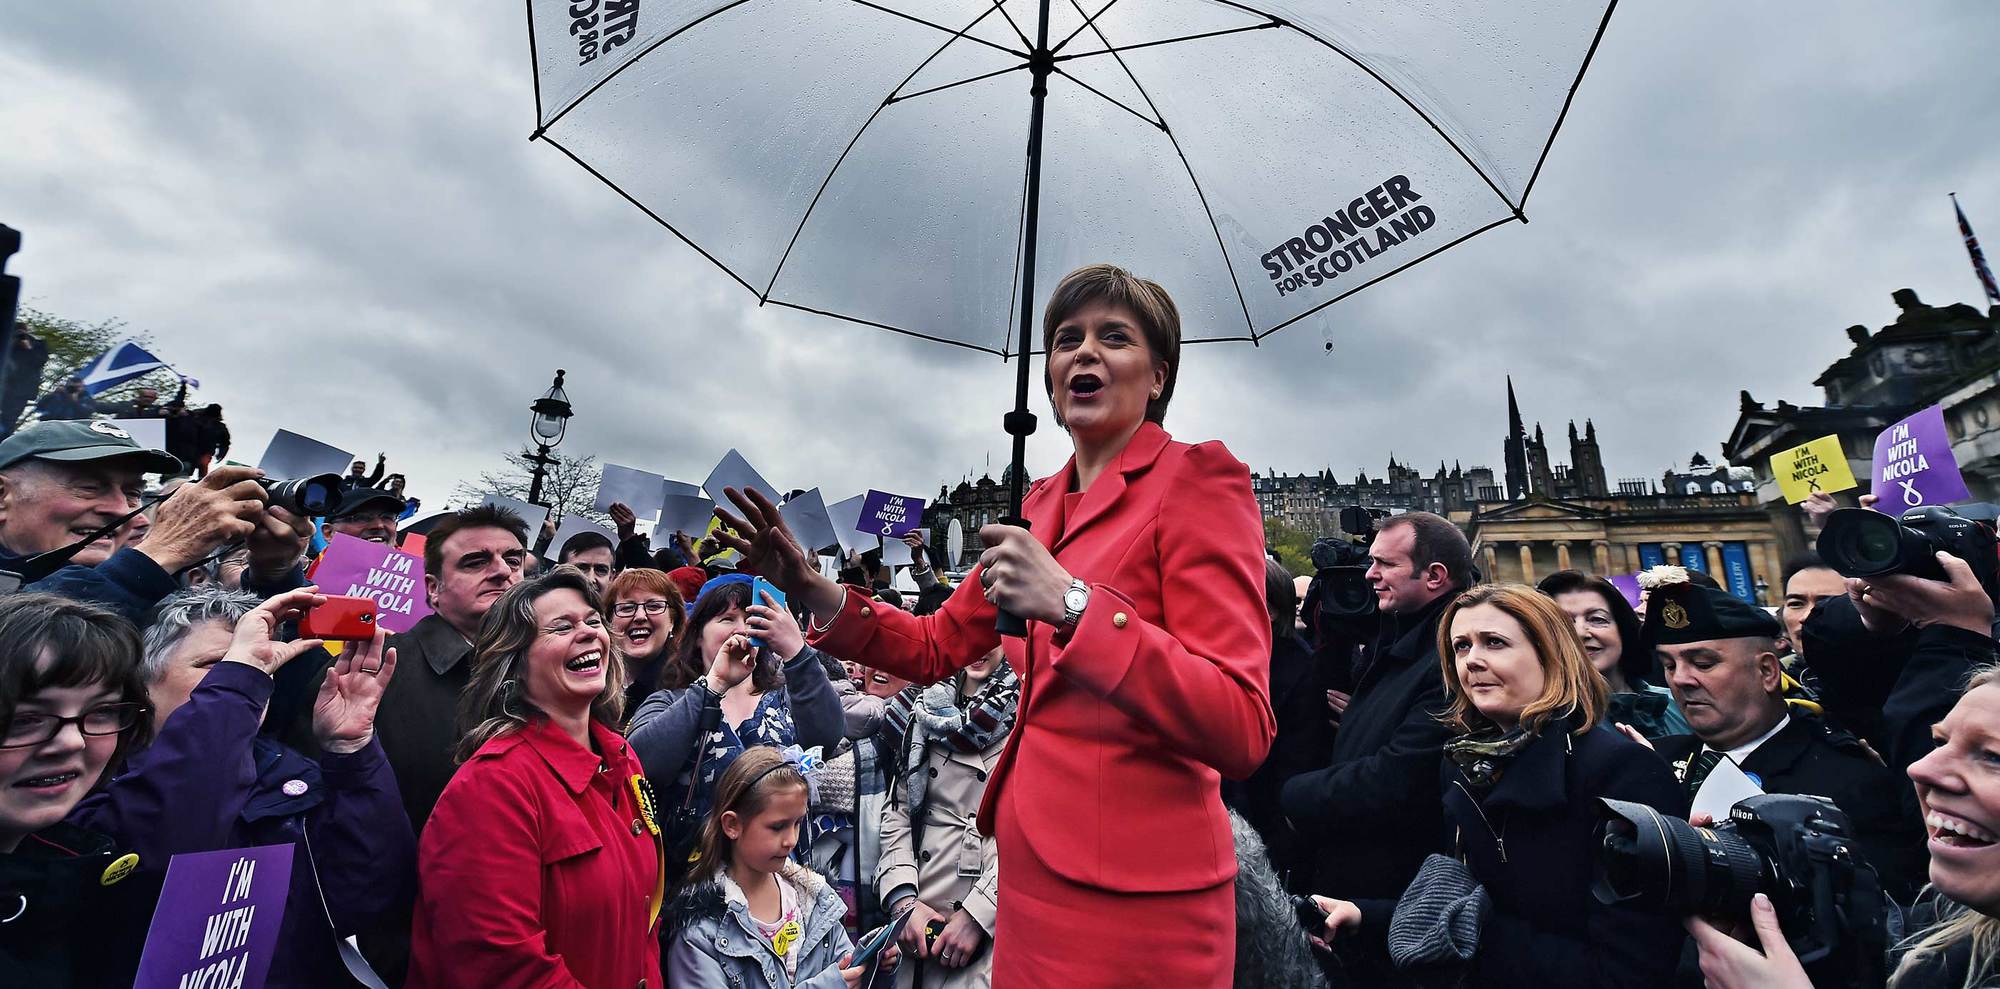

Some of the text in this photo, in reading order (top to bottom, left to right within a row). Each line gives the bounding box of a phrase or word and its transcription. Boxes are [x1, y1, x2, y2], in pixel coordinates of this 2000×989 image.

[1260, 174, 1423, 281] STRONGER
[1274, 205, 1436, 297] FOR SCOTLAND
[1892, 423, 1909, 444] I'M
[1795, 446, 1811, 460] I'M
[1887, 437, 1918, 463] WITH
[1791, 463, 1830, 482] NICOLA
[1793, 454, 1820, 470] WITH
[1882, 454, 1930, 483] NICOLA
[883, 503, 906, 515] WITH
[889, 496, 904, 506] I'M
[875, 510, 906, 523] NICOLA
[381, 553, 413, 574] I'M
[366, 567, 416, 595] WITH
[1731, 560, 1748, 598] GALLERY
[1731, 808, 1753, 820] Nikon
[221, 856, 256, 905] I'M
[200, 904, 256, 961] WITH
